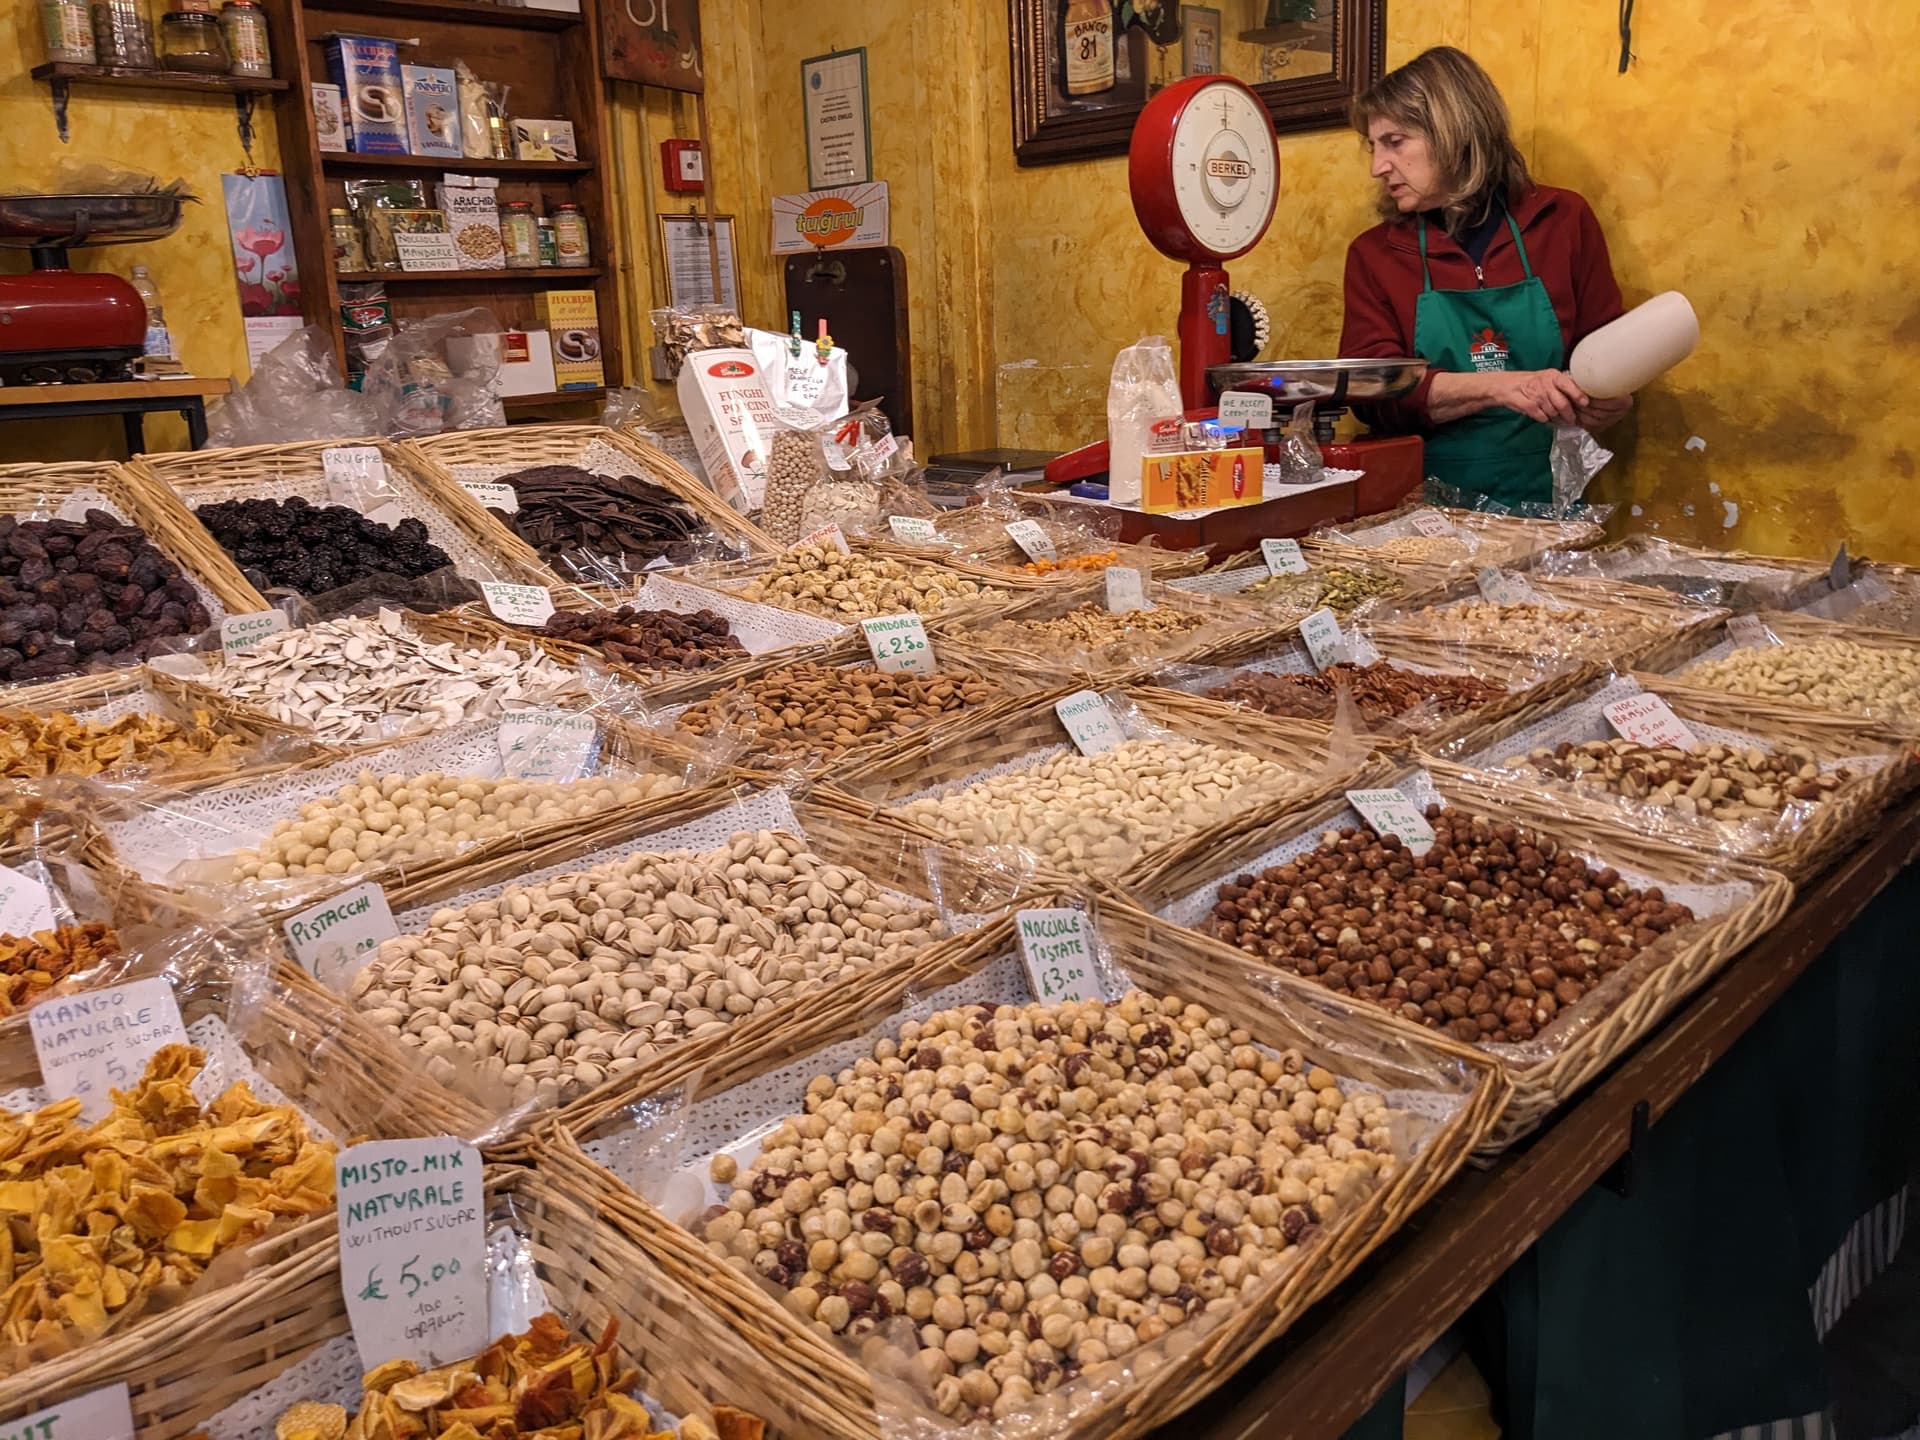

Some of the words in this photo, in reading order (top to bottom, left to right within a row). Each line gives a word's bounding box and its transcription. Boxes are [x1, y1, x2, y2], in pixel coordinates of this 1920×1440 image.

[1074, 20, 1108, 38] BANCO
[1080, 34, 1097, 60] 81
[1211, 162, 1248, 175] BERKEL
[796, 206, 864, 235] tuğrul
[402, 248, 454, 258] MANDORLE
[1475, 360, 1505, 368] MERCATO
[722, 401, 770, 414] POCINI
[484, 584, 545, 597] DATTERI
[227, 618, 273, 635] COCCO
[864, 618, 919, 634] MANDORLE
[889, 634, 924, 654] 2.50
[1058, 696, 1104, 719] MANDORLE
[1612, 701, 1660, 726] BRASILE
[1613, 700, 1639, 714] NOCI
[503, 712, 594, 731] MACADAMIA
[1022, 914, 1080, 938] NOCCIOLE
[1029, 939, 1084, 962] TOSTATE
[1049, 967, 1084, 990] 3.00
[35, 992, 125, 1029] MANGO
[42, 1007, 152, 1051] NATURALE
[47, 1041, 115, 1070] WITHOUT
[346, 1181, 464, 1227] NATURALE
[346, 1218, 424, 1248] WITHOUT
[424, 1208, 477, 1232] SUGAR
[400, 1254, 461, 1297] 5.00
